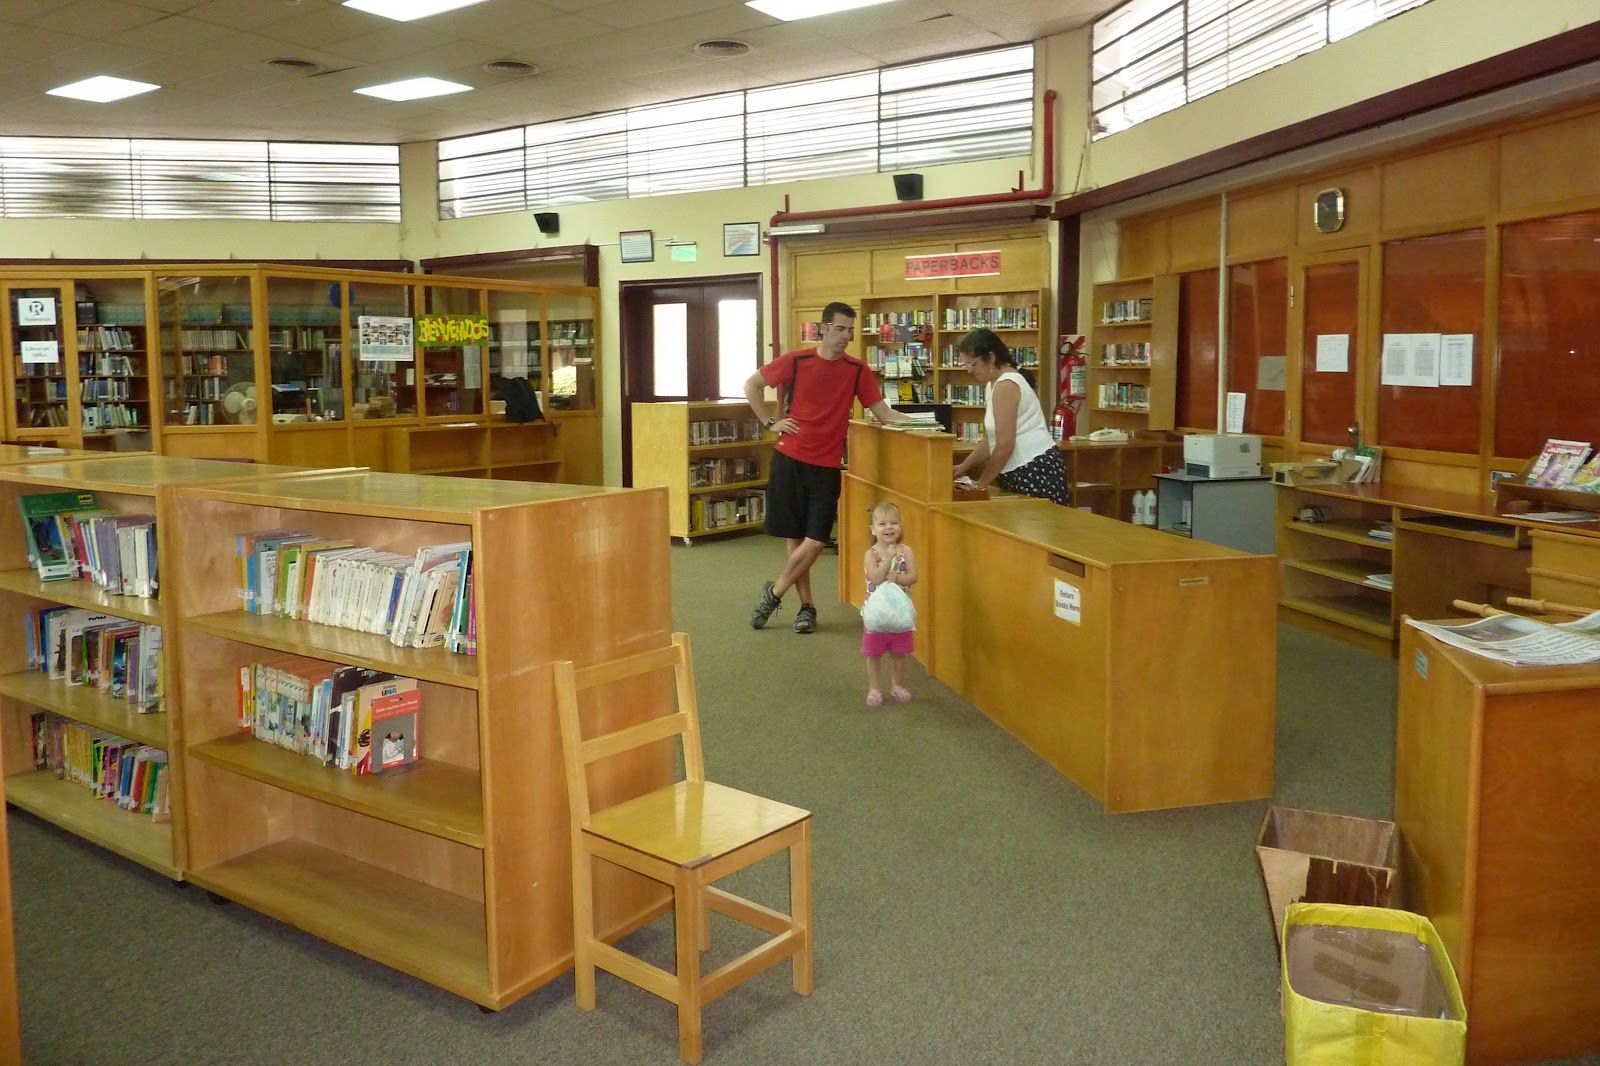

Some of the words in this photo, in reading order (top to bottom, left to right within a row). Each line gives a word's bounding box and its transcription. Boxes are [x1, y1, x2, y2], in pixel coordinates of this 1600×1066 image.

[905, 255, 1001, 274] PAPERBACKS
[1060, 589, 1075, 600] Return
[1055, 600, 1069, 610] Books
[1069, 603, 1081, 613] Here
